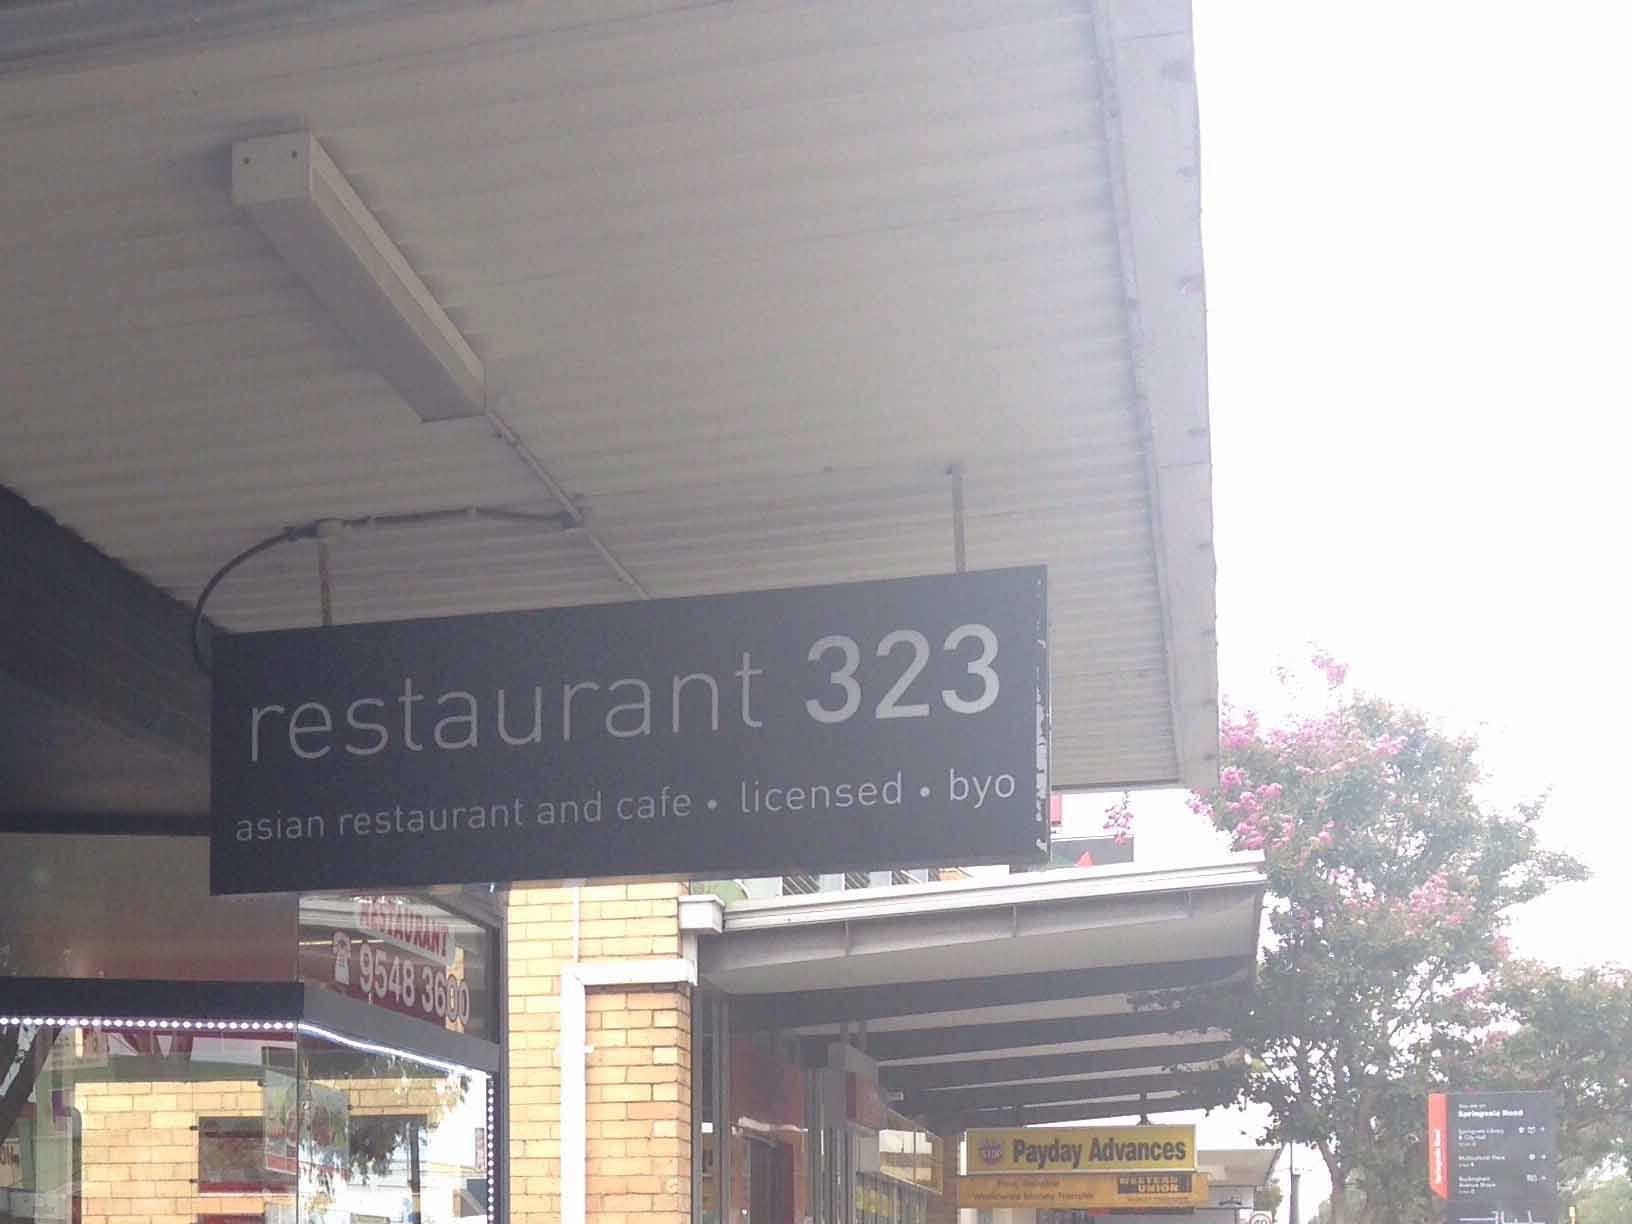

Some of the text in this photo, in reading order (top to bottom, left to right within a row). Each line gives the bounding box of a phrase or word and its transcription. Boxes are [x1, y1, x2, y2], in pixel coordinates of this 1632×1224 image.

[250, 623, 1001, 761] restaurant 323
[234, 767, 1016, 843] asian restaurant and cafe licensed byo
[360, 943, 470, 1025] 9548 3600
[1013, 1136, 1186, 1169] Payday Advances
[1138, 1183, 1179, 1193] UNION
